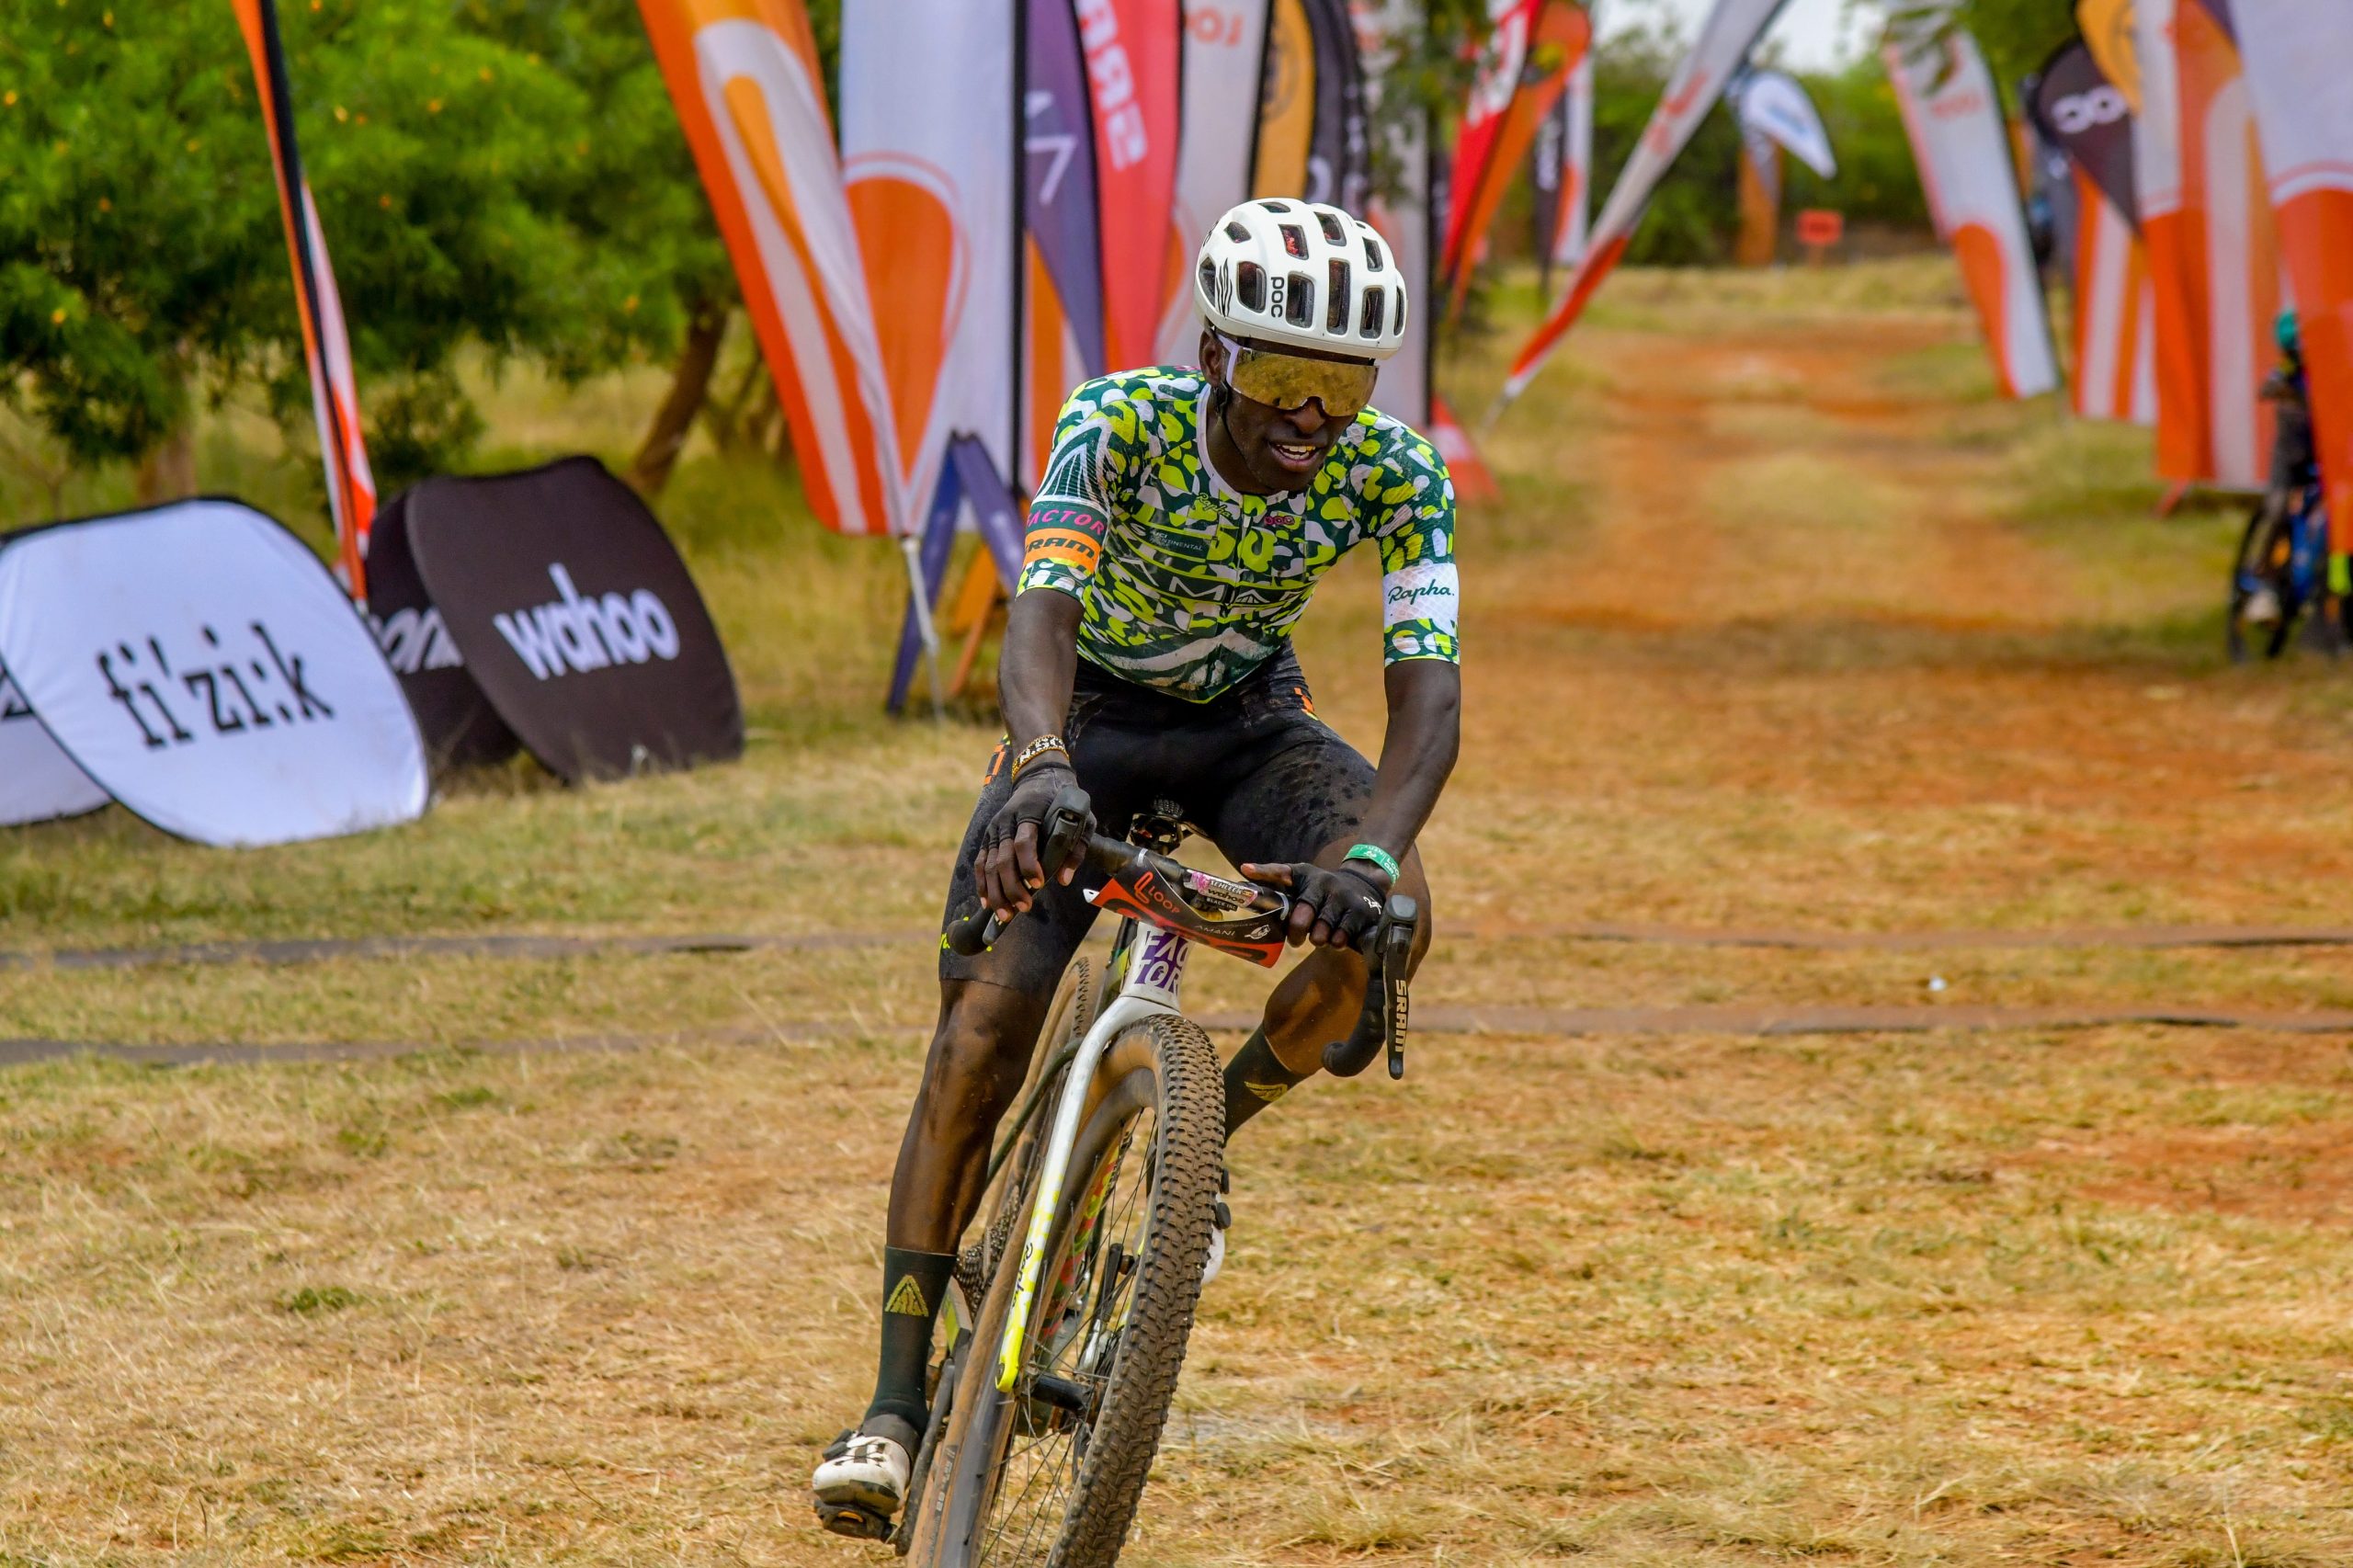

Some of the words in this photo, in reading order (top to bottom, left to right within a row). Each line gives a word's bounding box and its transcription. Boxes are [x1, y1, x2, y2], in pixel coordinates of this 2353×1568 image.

[1026, 508, 1106, 536] ACTOR
[1026, 538, 1096, 560] RAM
[493, 562, 681, 681] wahoo
[1148, 885, 1181, 913] LOOP
[1208, 888, 1245, 904] wahoo
[1394, 979, 1407, 1052] SRAM
